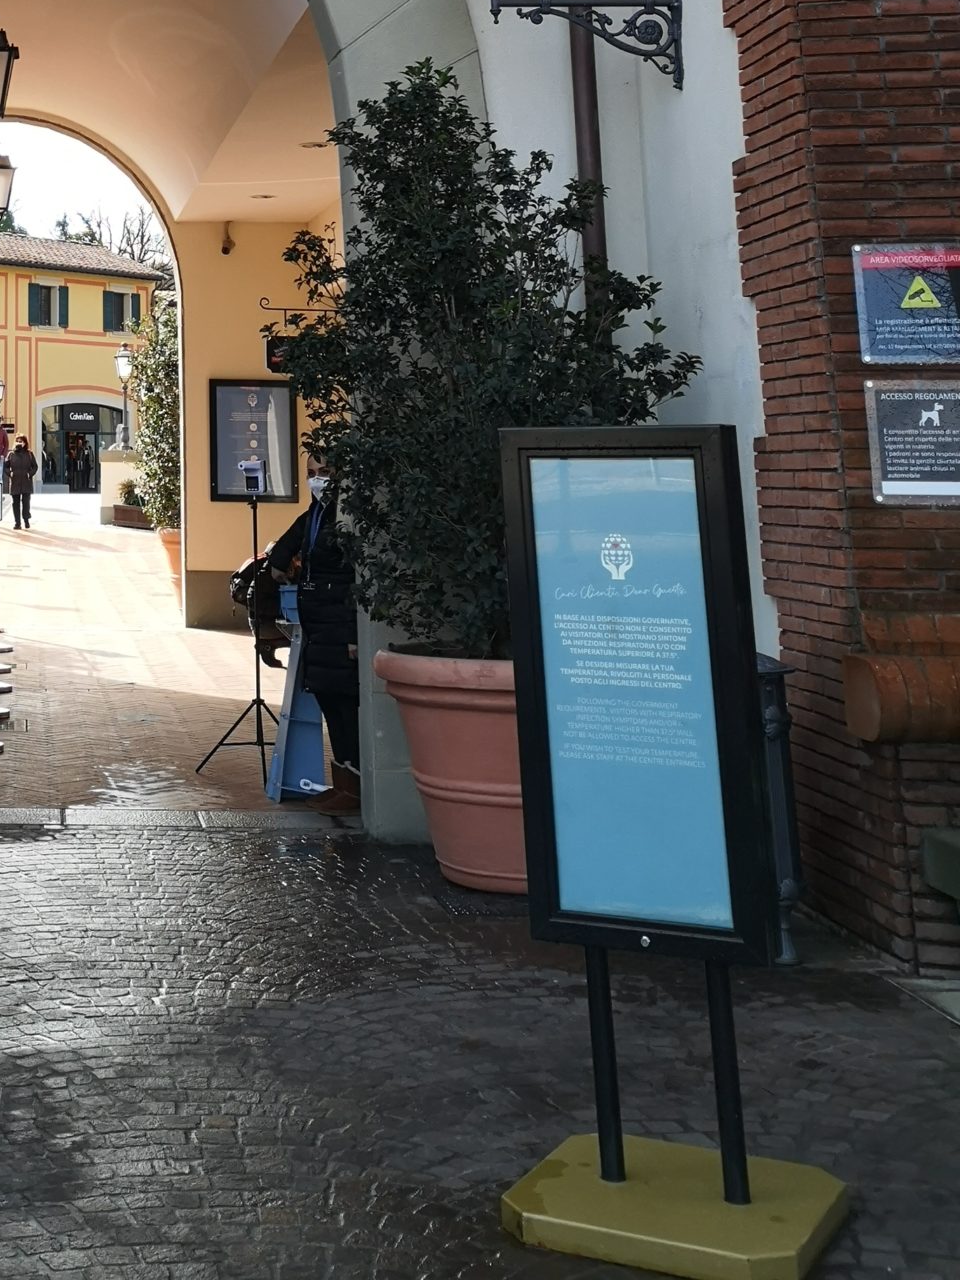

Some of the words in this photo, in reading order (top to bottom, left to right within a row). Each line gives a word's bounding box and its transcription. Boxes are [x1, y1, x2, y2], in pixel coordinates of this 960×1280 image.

[870, 256, 890, 264] AREA
[596, 615, 641, 623] DISPOSIZIONI
[554, 622, 589, 630] L'ACCESSO
[649, 626, 692, 634] CONSENTITO
[619, 633, 657, 641] MOSTRANO
[609, 641, 656, 650] RESPIRATORIA
[570, 647, 617, 656] TEMPERATURA
[618, 650, 655, 658] SUPERIORE
[615, 662, 650, 670] MISURARE
[610, 671, 643, 679] RIVOLGITI
[652, 673, 692, 681] PERSONALE
[609, 679, 640, 687] INGRESSI
